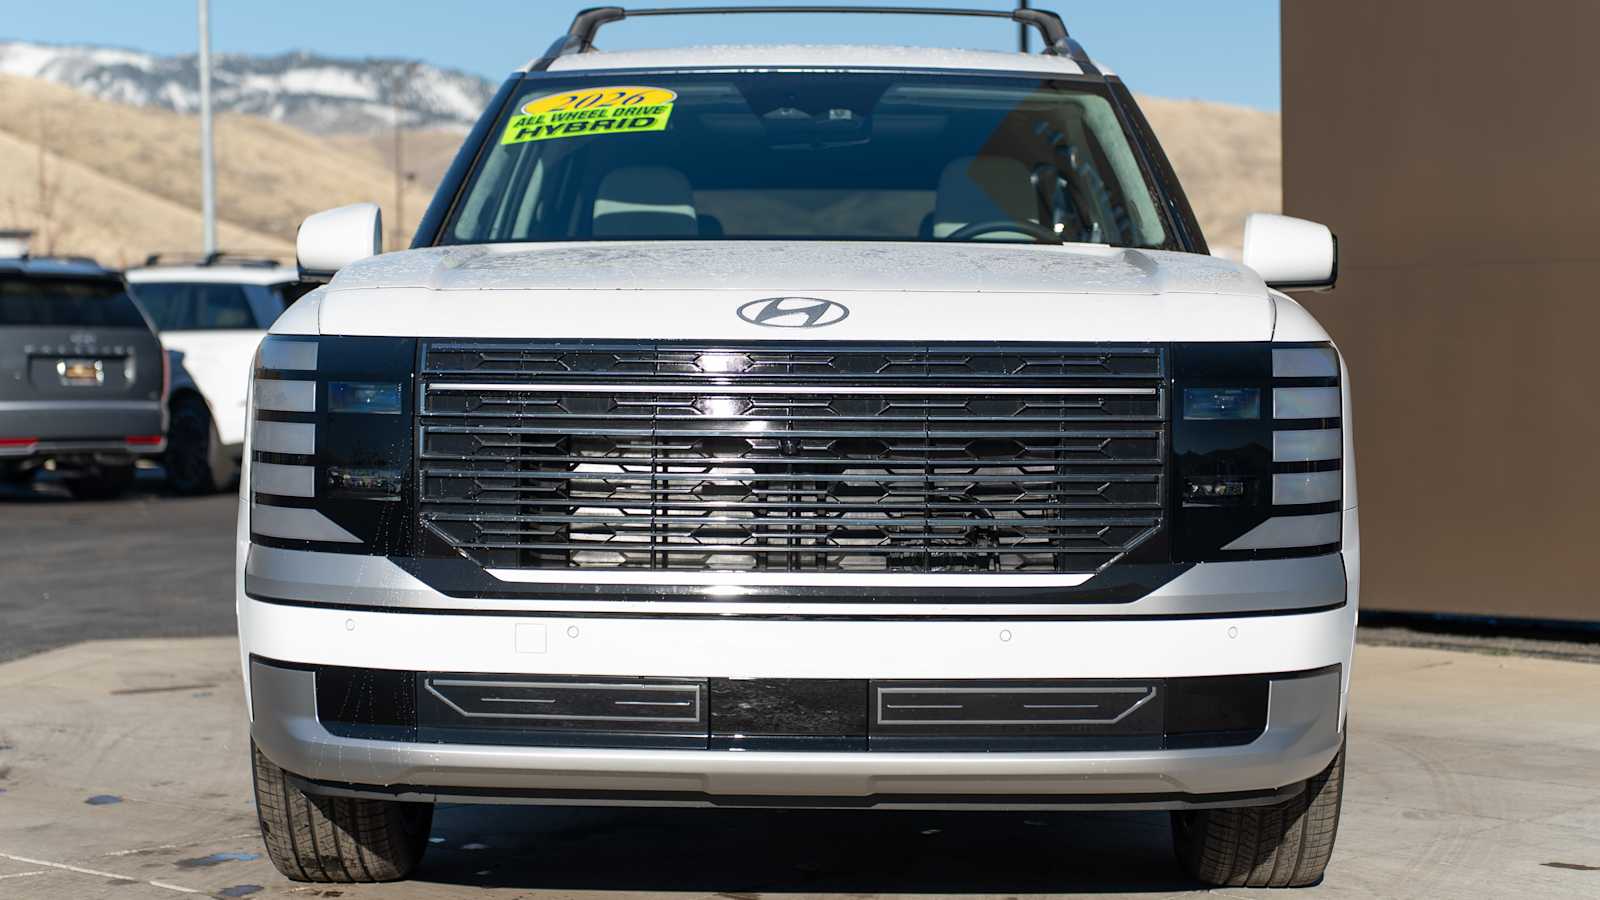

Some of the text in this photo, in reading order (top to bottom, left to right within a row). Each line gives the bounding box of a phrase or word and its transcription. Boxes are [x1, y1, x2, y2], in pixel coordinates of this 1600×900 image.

[550, 91, 645, 111] 2026
[514, 105, 664, 127] ALL WHEEL DRIVE
[515, 117, 656, 140] HYBRID
